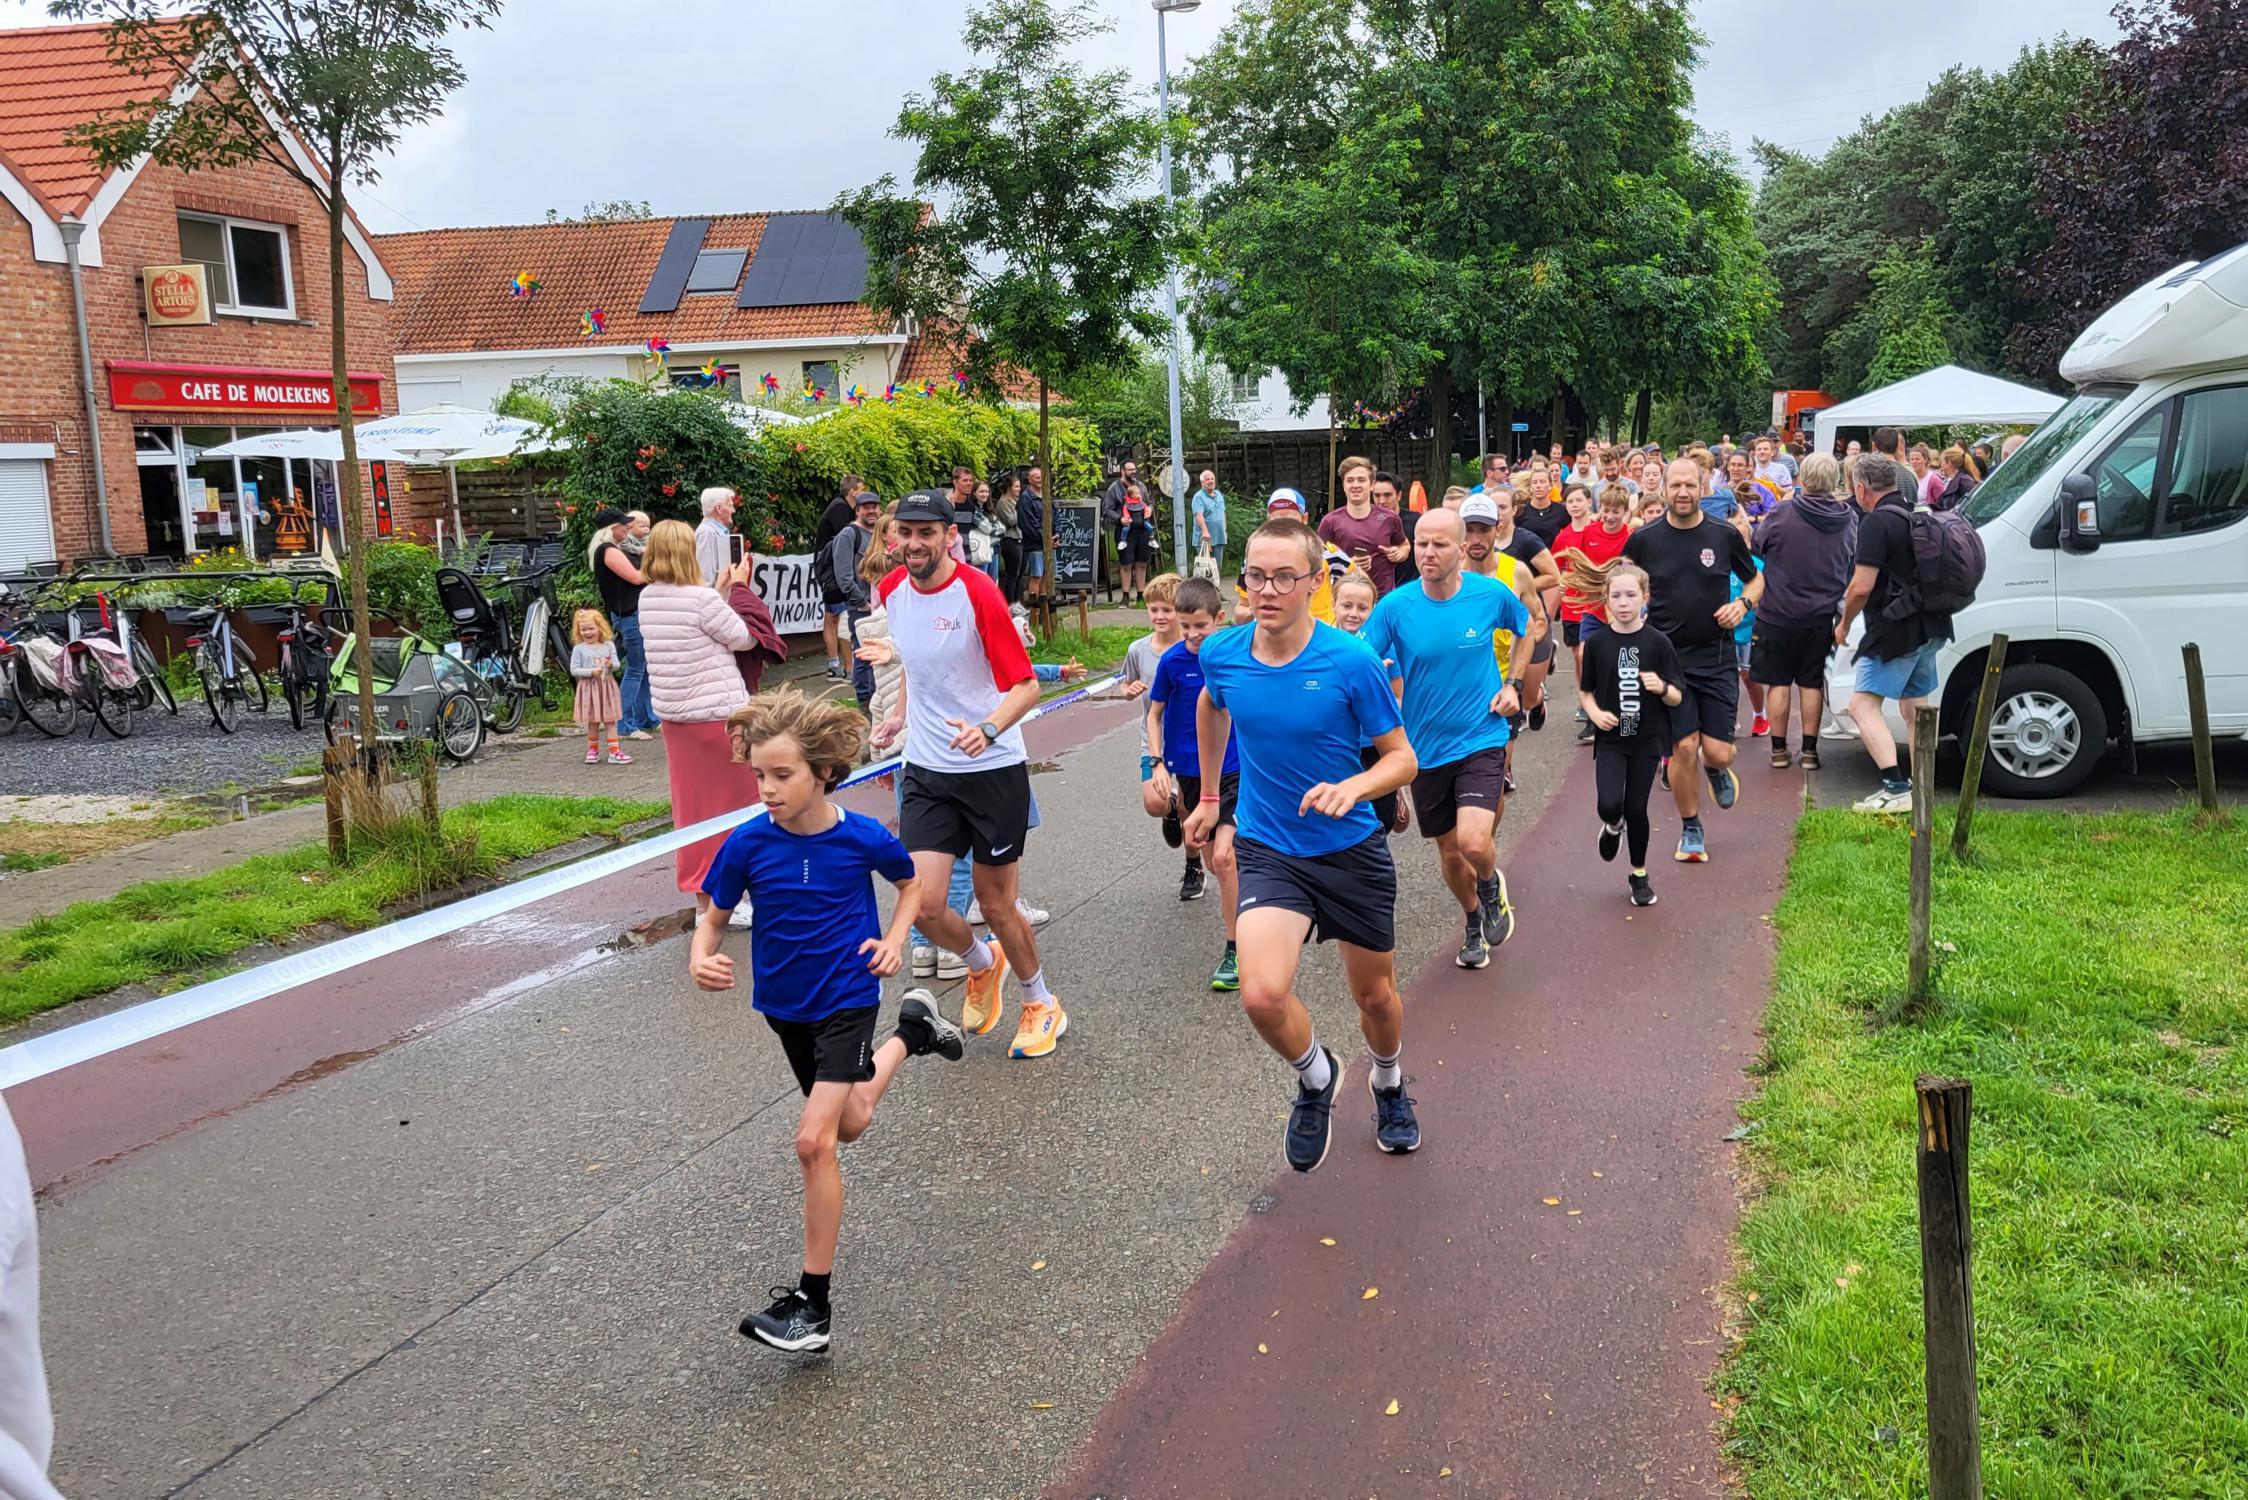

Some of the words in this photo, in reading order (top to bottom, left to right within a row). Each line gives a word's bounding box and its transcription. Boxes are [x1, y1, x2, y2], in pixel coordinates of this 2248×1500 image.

[154, 285, 194, 297] STELLA
[156, 295, 194, 307] ARTOIS
[181, 383, 222, 400] CAFE
[227, 384, 248, 401] DE
[254, 385, 330, 403] MOLEKENS
[372, 463, 393, 535] PALM
[754, 563, 819, 601] STAR
[768, 602, 824, 625] NKOMS
[1618, 647, 1640, 668] AS
[1618, 667, 1641, 712] BOLD
[1620, 717, 1640, 737] BE
